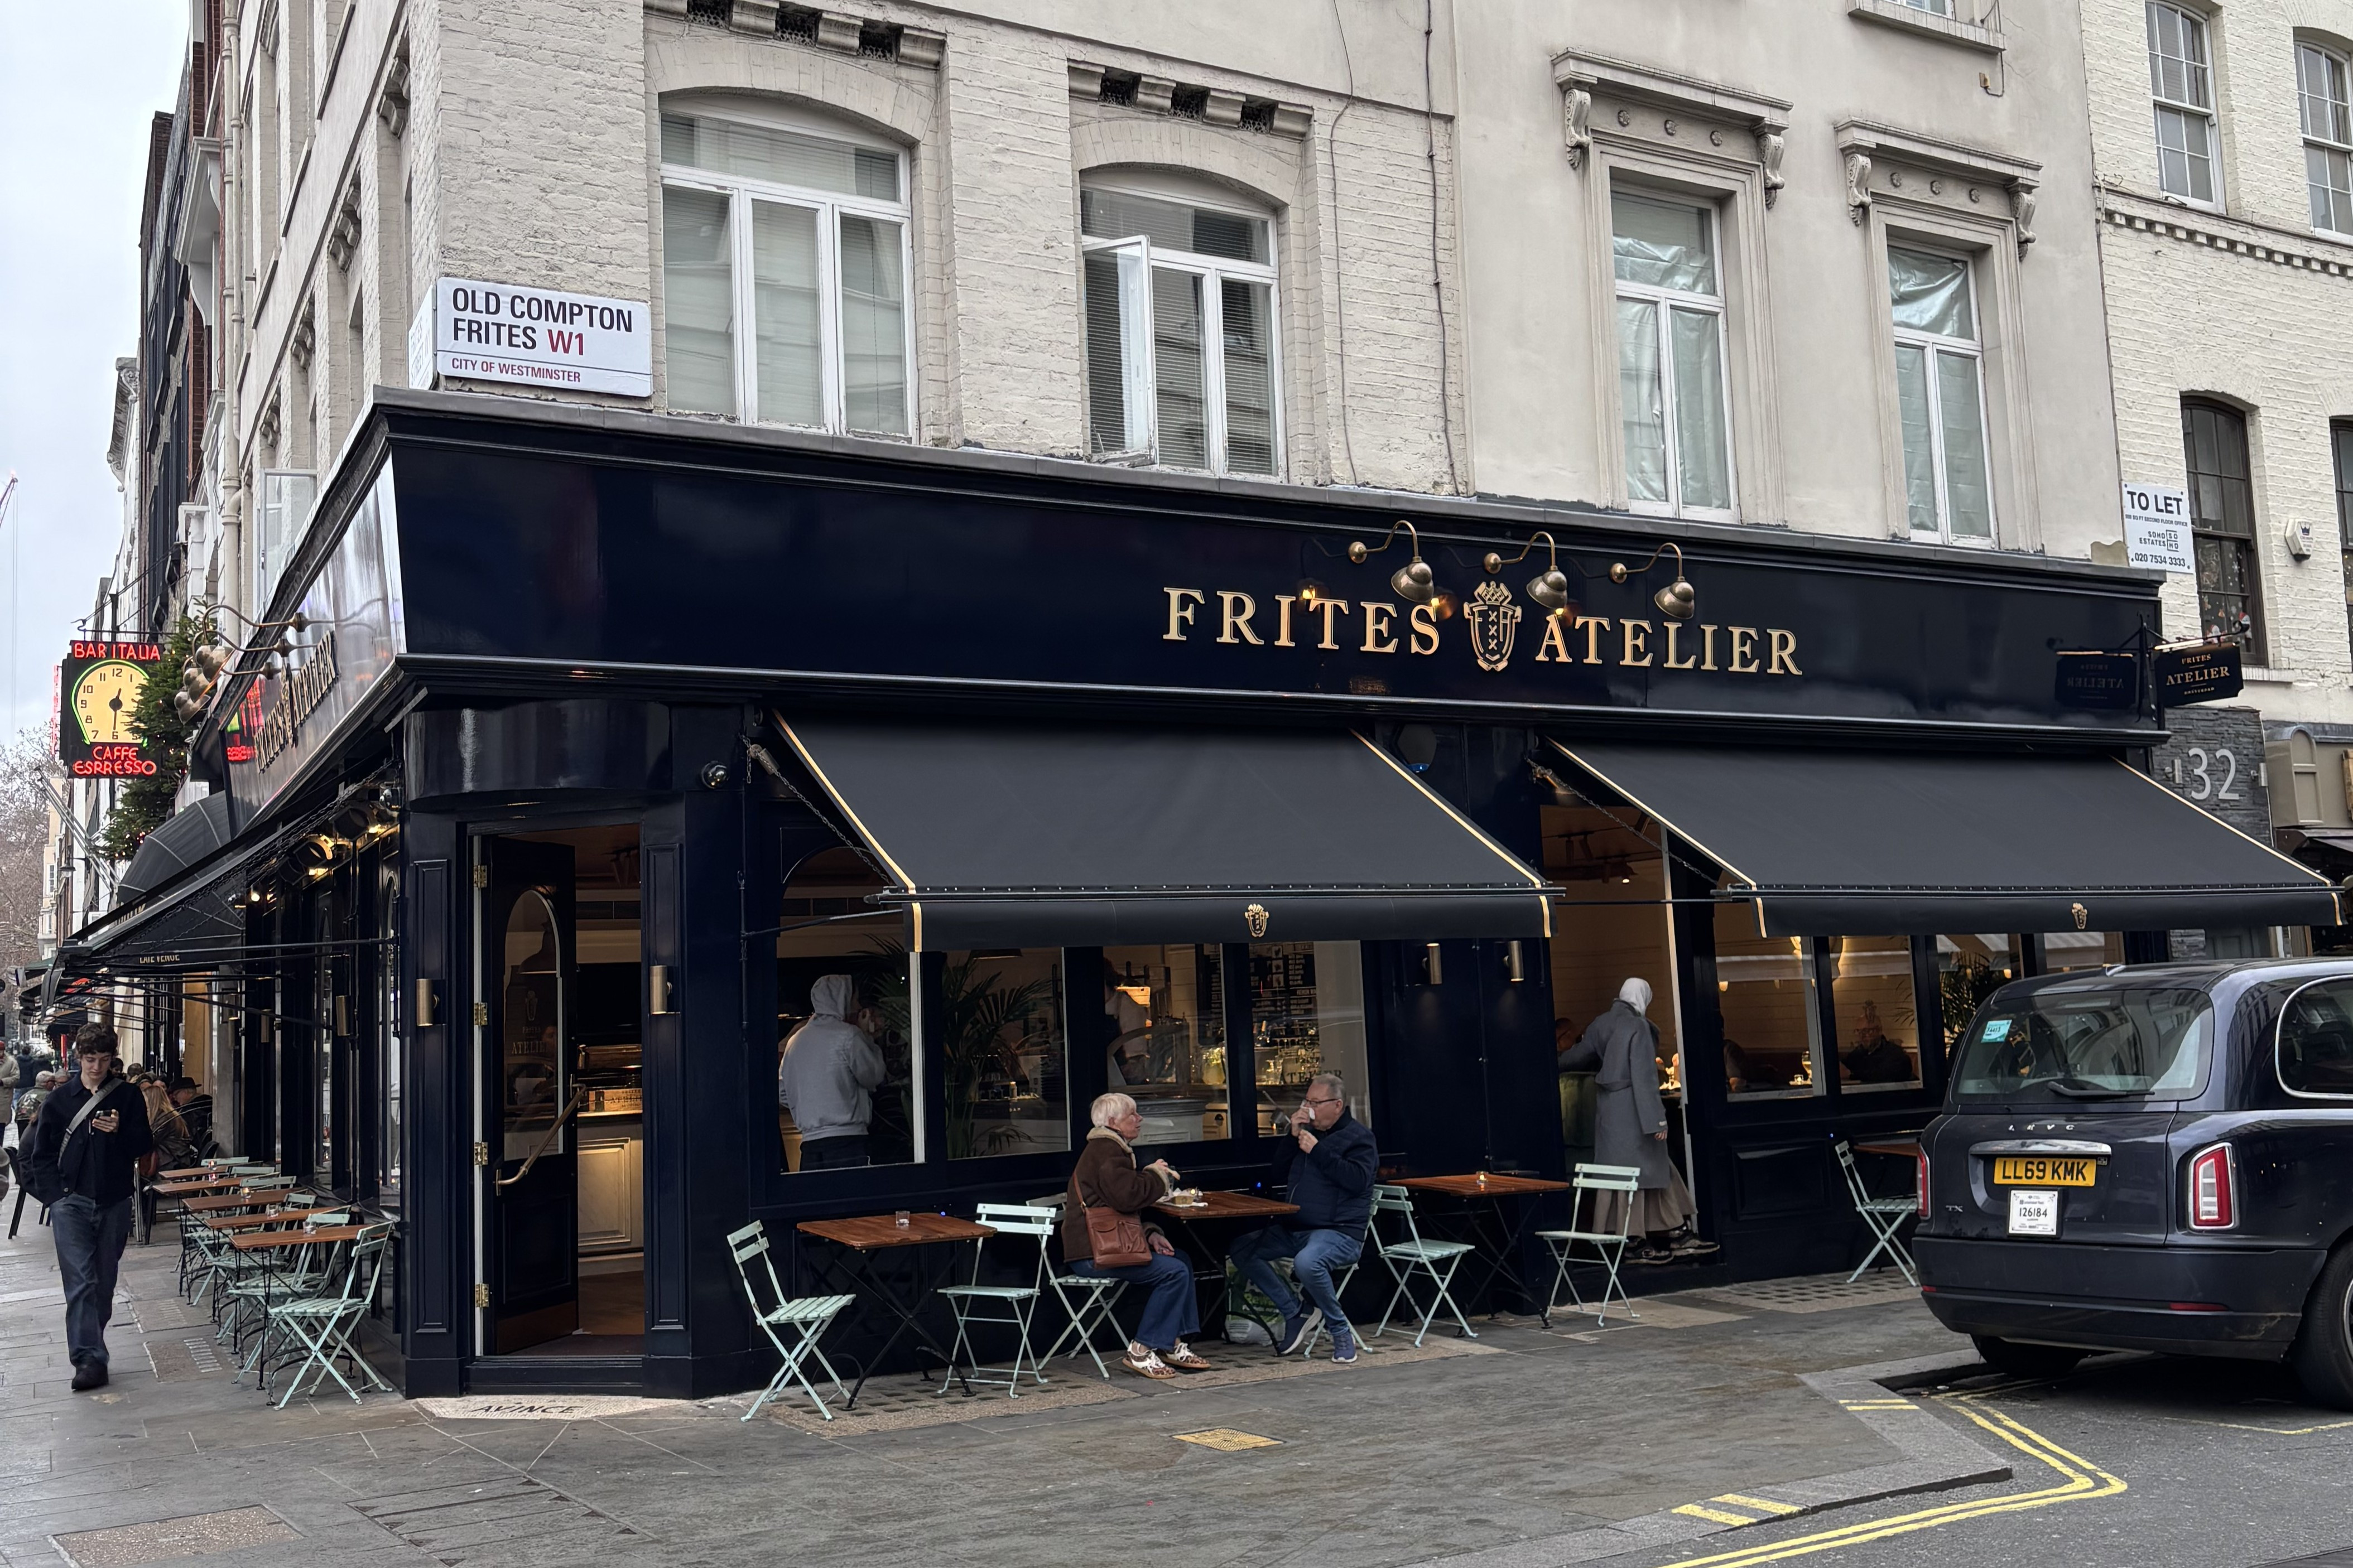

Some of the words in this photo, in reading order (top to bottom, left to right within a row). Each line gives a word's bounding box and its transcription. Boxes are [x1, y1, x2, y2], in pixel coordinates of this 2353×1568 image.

[453, 287, 501, 315] OLD
[510, 295, 632, 332] COMPTON
[453, 317, 537, 350] FRITES
[547, 329, 584, 355] W1
[452, 358, 477, 371] CITY
[481, 361, 494, 372] OF
[498, 363, 580, 382] WESTMINSTER
[2127, 491, 2149, 510] TO
[2154, 494, 2182, 515] LET
[2139, 538, 2166, 547] ESTATES
[2135, 553, 2148, 562] 020
[2149, 554, 2167, 565] 7534
[2168, 557, 2186, 567] 3333
[1162, 586, 1440, 656] FRITES
[1535, 614, 1804, 677] ATELIER
[74, 643, 107, 659] BAR
[112, 644, 161, 660] ITALIA
[2182, 654, 2211, 664] FRITES
[99, 673, 105, 681] 11
[112, 668, 122, 677] 12
[291, 630, 336, 728] ATELIER
[2166, 666, 2230, 686] ATELIER
[83, 685, 93, 693] 10
[80, 699, 86, 708] 9
[92, 730, 99, 739] 7
[112, 731, 118, 740] 6
[93, 746, 138, 760] CAFFE
[2188, 747, 2239, 800] 32
[2002, 1160, 2046, 1180] LL69
[2051, 1161, 2087, 1181] KMK
[2019, 1207, 2048, 1218] 126184
